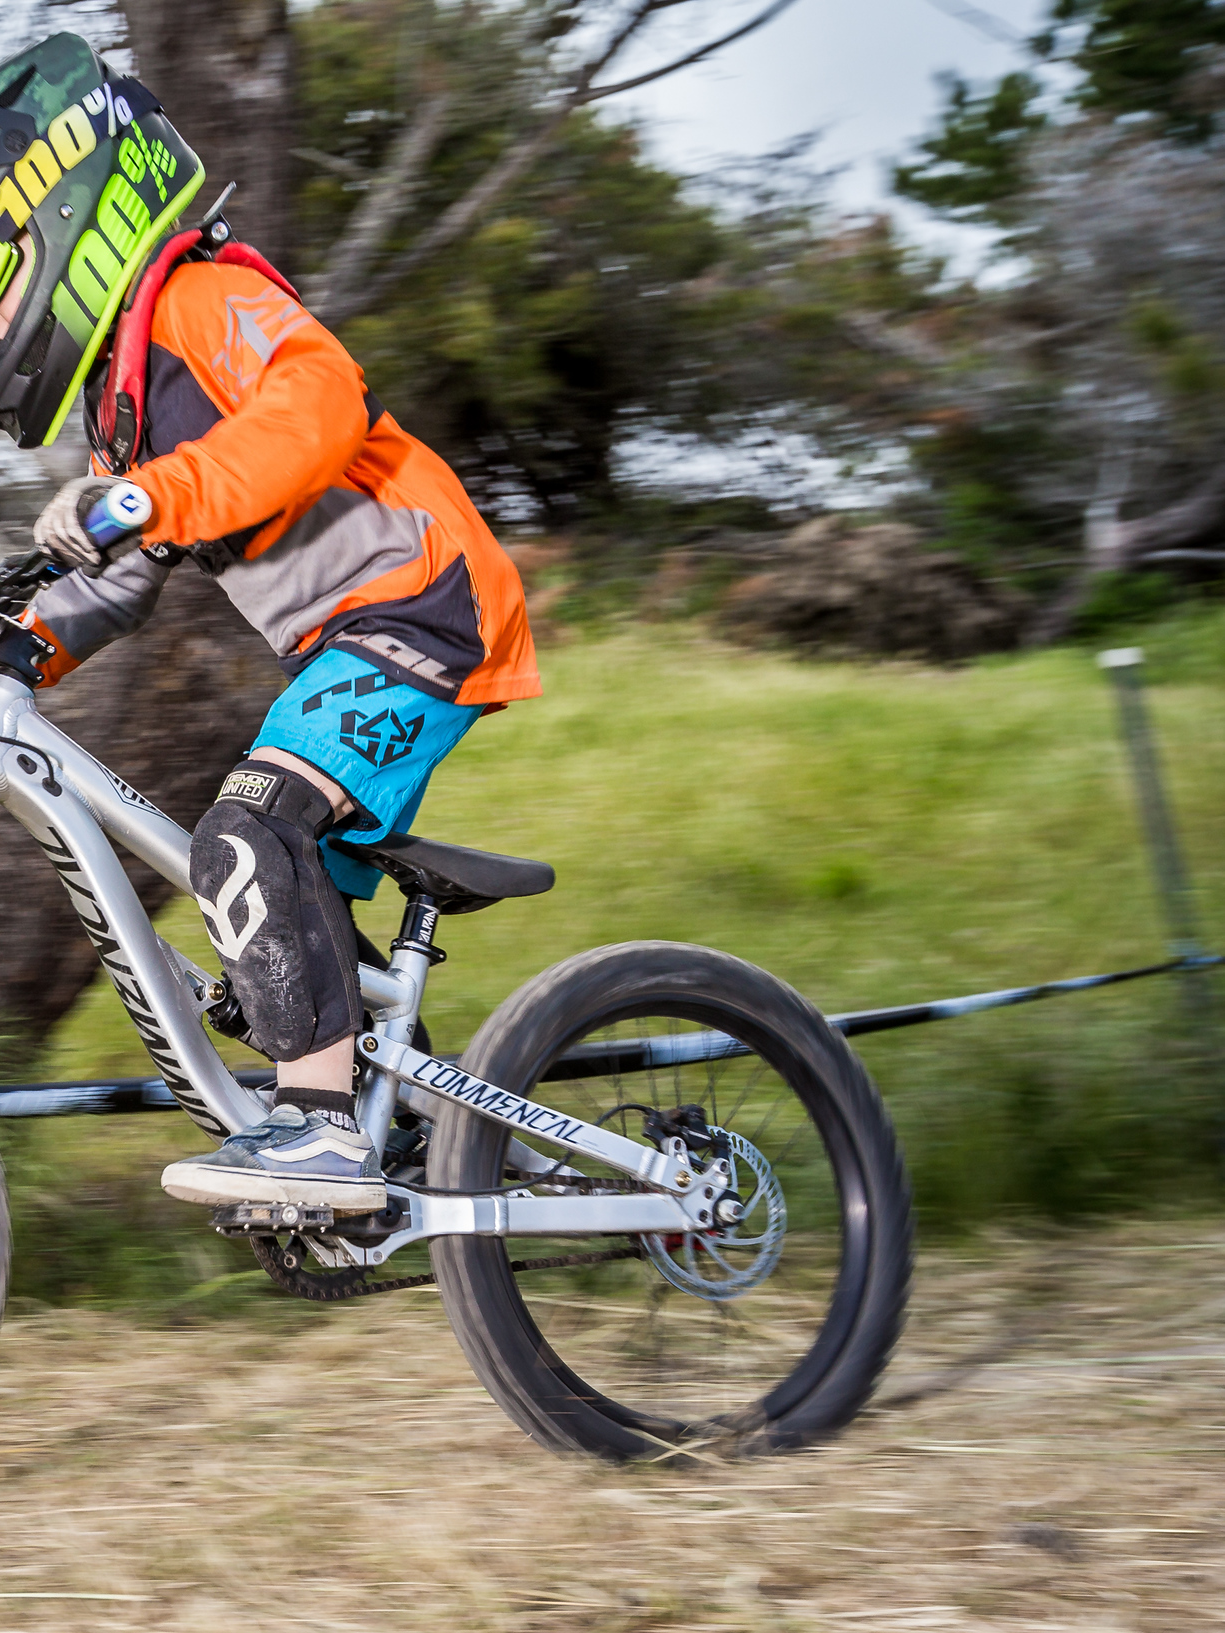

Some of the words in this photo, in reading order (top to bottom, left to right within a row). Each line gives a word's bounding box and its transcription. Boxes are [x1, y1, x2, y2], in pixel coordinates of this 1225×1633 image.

[52, 119, 178, 352] 100%
[223, 782, 263, 798] UNITED
[229, 773, 270, 787] DEMON
[34, 826, 232, 1138] OMMENCAL
[412, 1058, 585, 1145] COMMENCAL
